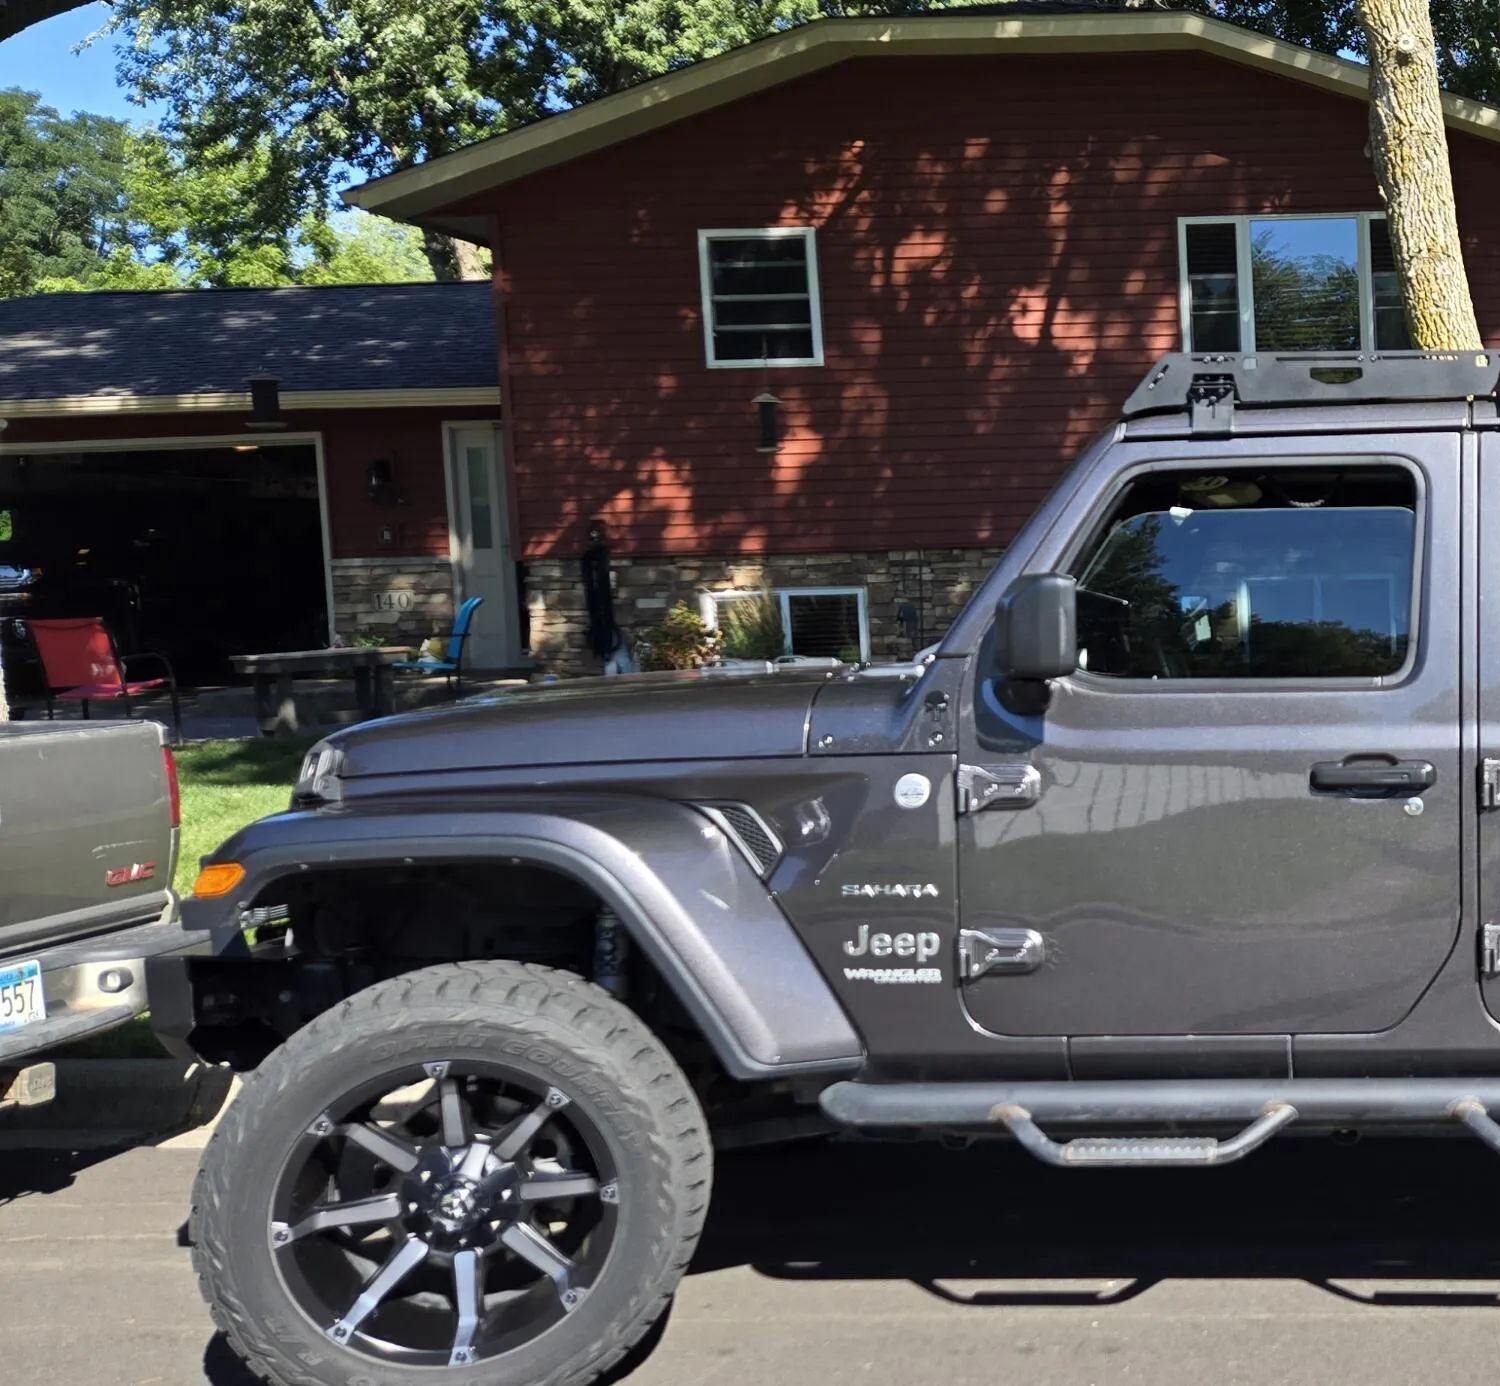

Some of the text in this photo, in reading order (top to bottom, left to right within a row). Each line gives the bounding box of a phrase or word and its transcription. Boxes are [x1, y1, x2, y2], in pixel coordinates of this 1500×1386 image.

[375, 593, 410, 610] 140
[106, 860, 156, 887] GMC
[841, 883, 938, 898] SAHARA
[843, 924, 941, 963] Jeep
[369, 1031, 485, 1062] OPEN
